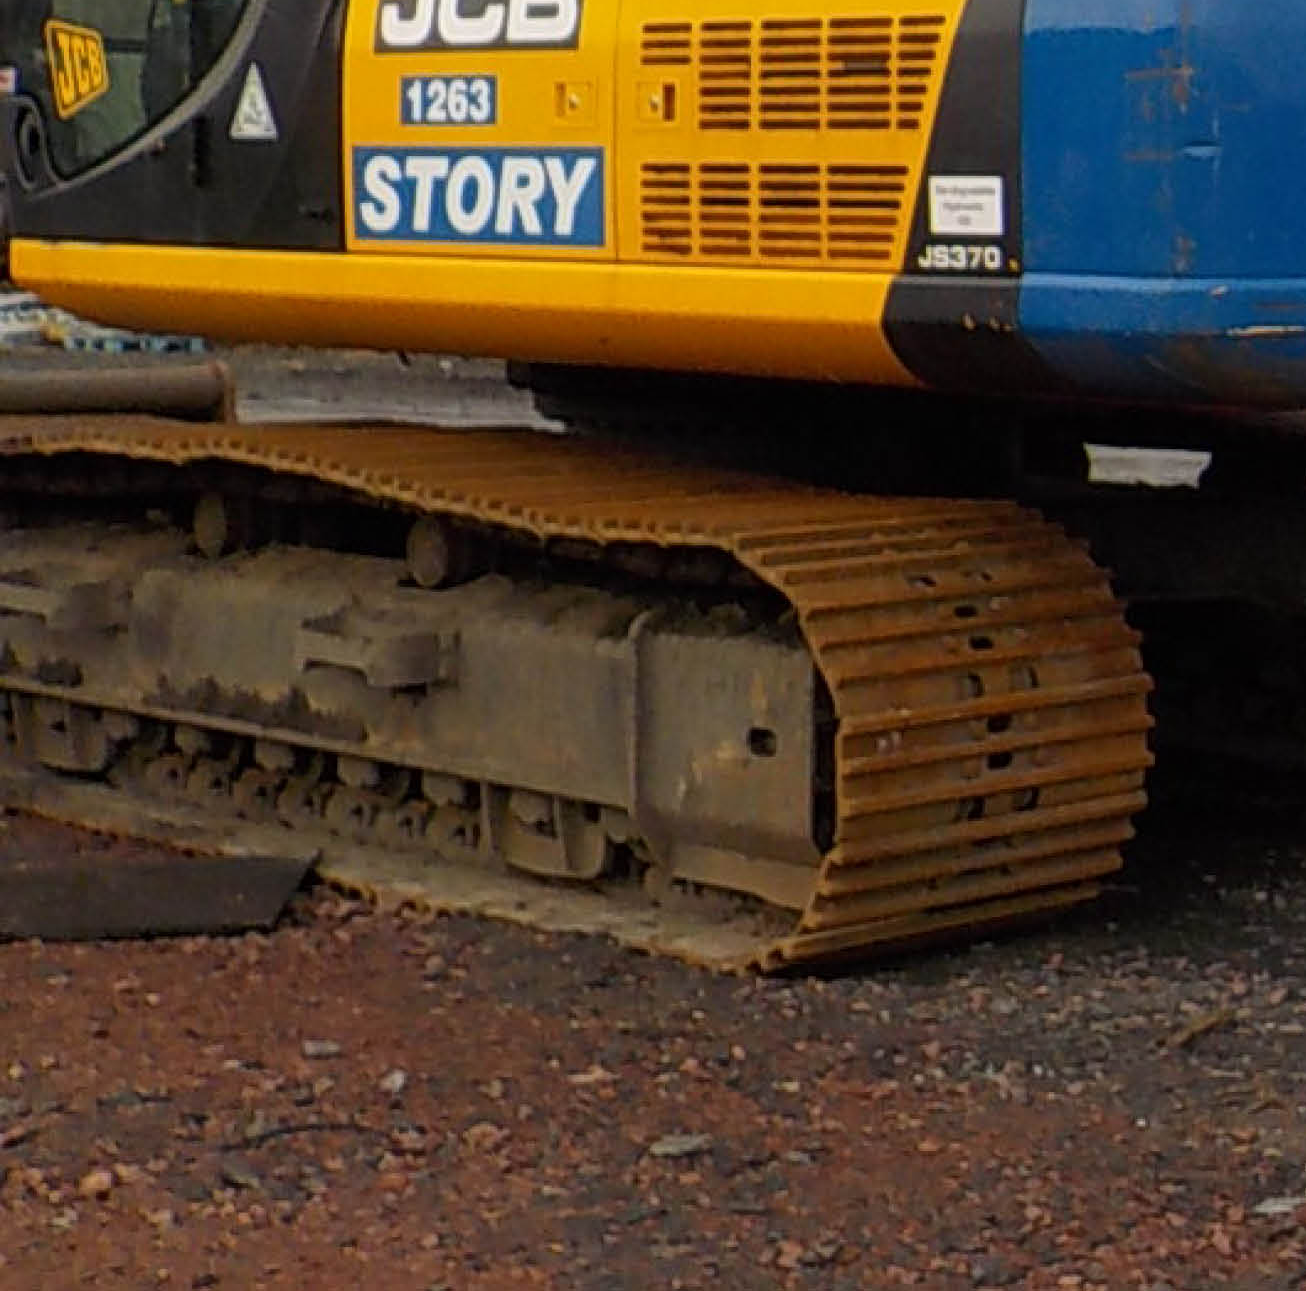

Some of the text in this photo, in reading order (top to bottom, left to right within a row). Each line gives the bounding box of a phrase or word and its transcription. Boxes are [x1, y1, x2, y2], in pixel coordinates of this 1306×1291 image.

[56, 30, 103, 105] JCB
[405, 79, 491, 122] 1263
[359, 155, 596, 237] STORY
[917, 244, 1001, 269] JS370
